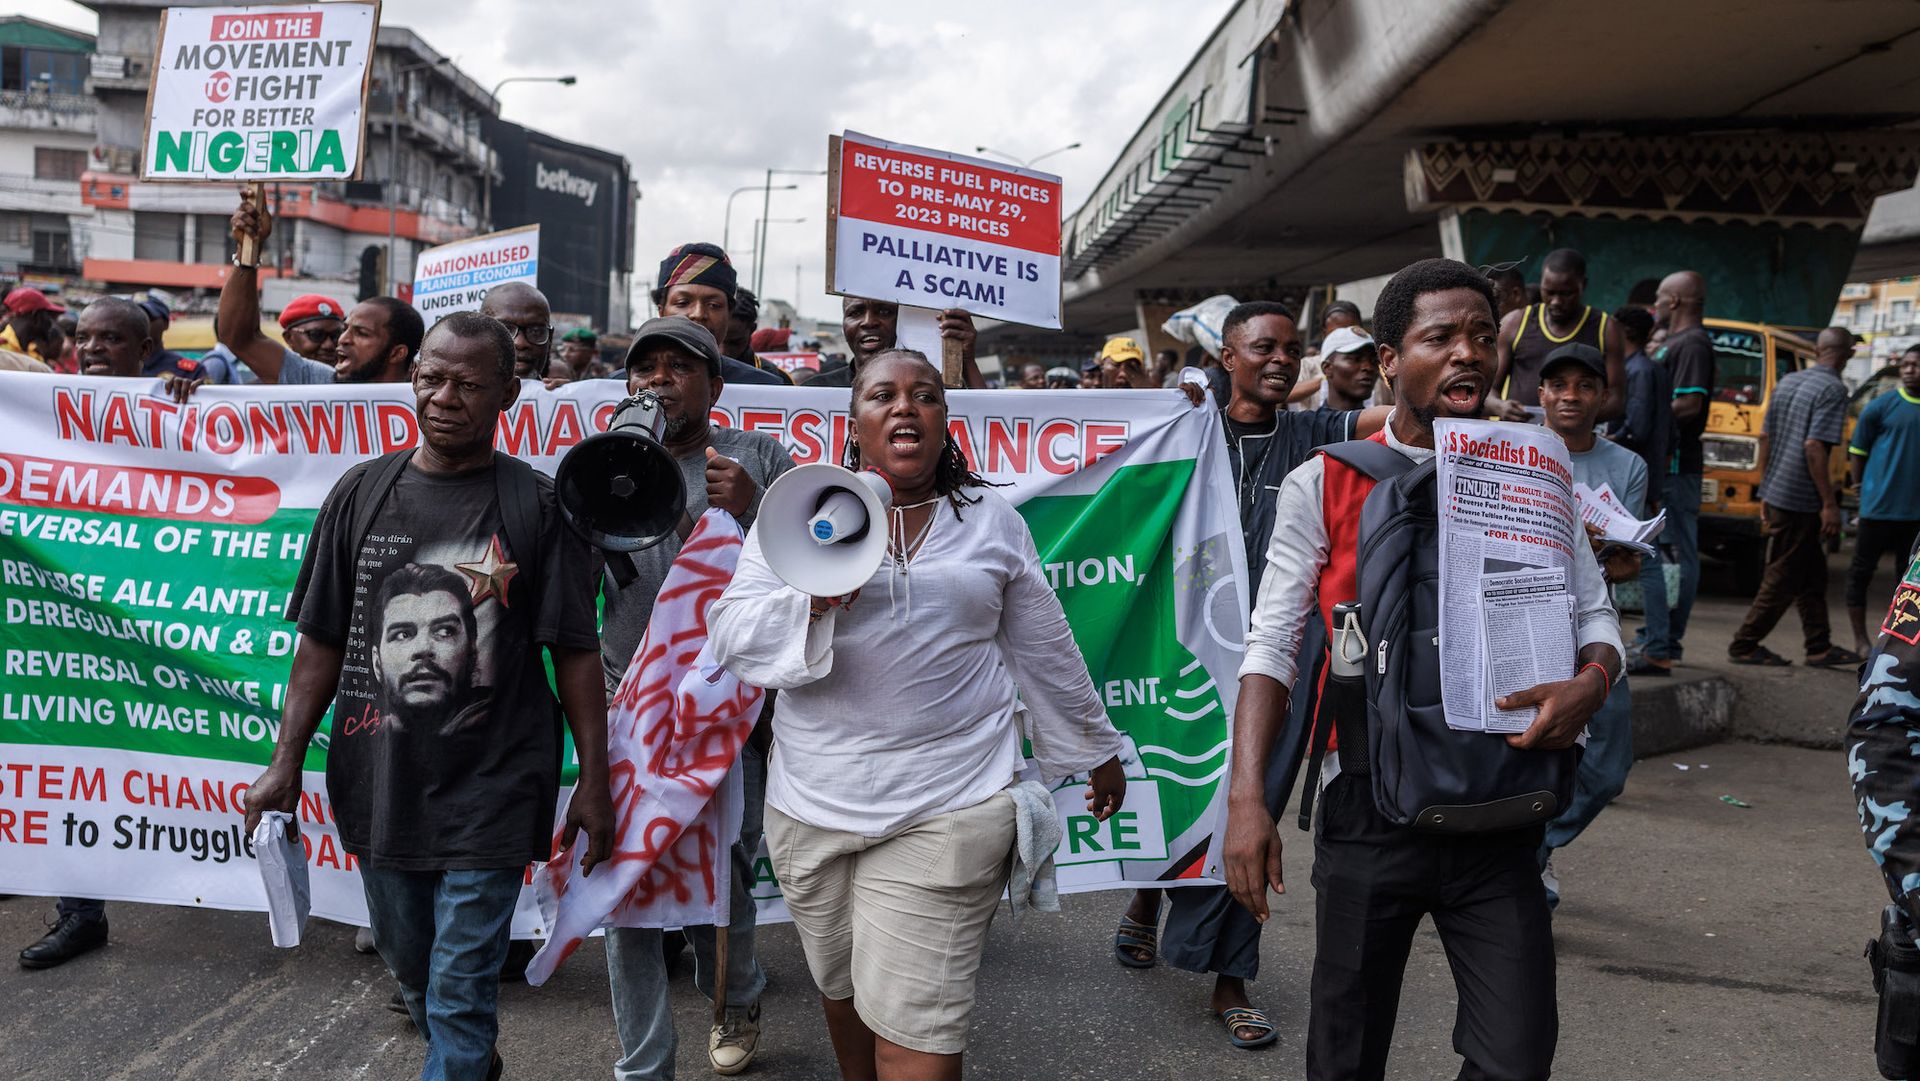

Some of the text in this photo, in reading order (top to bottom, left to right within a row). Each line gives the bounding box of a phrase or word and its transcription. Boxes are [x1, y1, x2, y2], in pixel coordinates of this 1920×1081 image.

[219, 18, 313, 39] JOIN THE
[174, 41, 352, 69] MOVEMENT
[206, 74, 323, 101] TO FIGHT
[193, 107, 315, 127] FOR BETTER
[154, 129, 346, 173] NIGERIA
[536, 162, 598, 206] betway
[854, 152, 1050, 204] REVERSE FUEL PRICES
[878, 179, 1027, 222] TO PRE-MAY 29,
[895, 204, 1010, 237] 2023 PRICES
[423, 245, 529, 278] NATIONALISED
[862, 232, 1039, 282] PALLIATIVE IS
[420, 263, 529, 292] PLANNED ECONOMY
[895, 269, 1005, 306] A SCAM!
[422, 289, 487, 311] UNDER WO
[1460, 433, 1525, 465] Socialist
[1484, 462, 1494, 470] the
[1495, 464, 1531, 476] Democratic
[1456, 477, 1499, 499] TINUBU:
[1514, 485, 1542, 498] ABSOLUTE
[1457, 506, 1481, 517] Reverse
[1482, 511, 1503, 521] Tuition
[1504, 514, 1515, 522] Fee
[1531, 519, 1542, 527] and
[1458, 497, 1483, 508] Reverse
[1484, 500, 1499, 510] Fuel
[1501, 503, 1517, 513] Price
[1535, 509, 1542, 517] to
[154, 526, 201, 554] OF
[211, 530, 269, 559] THE
[1488, 530, 1509, 540] FOR
[1511, 533, 1519, 541] A
[1520, 535, 1562, 551] SOCIALIST
[2, 559, 293, 620] REVERSE ALL ANTI-
[1489, 578, 1513, 587] Democratic
[1514, 576, 1533, 584] Socialist
[1533, 574, 1555, 583] Movement
[6, 598, 220, 652] DEREGULATION
[229, 629, 254, 655] &
[5, 649, 147, 686] REVERSAL
[153, 664, 192, 690] OF
[192, 671, 260, 706] HIKE
[1098, 677, 1168, 707] ENT.
[2, 693, 116, 726] LIVING
[124, 701, 210, 736] WAGE
[62, 812, 99, 848] to
[112, 814, 256, 864] Struggle
